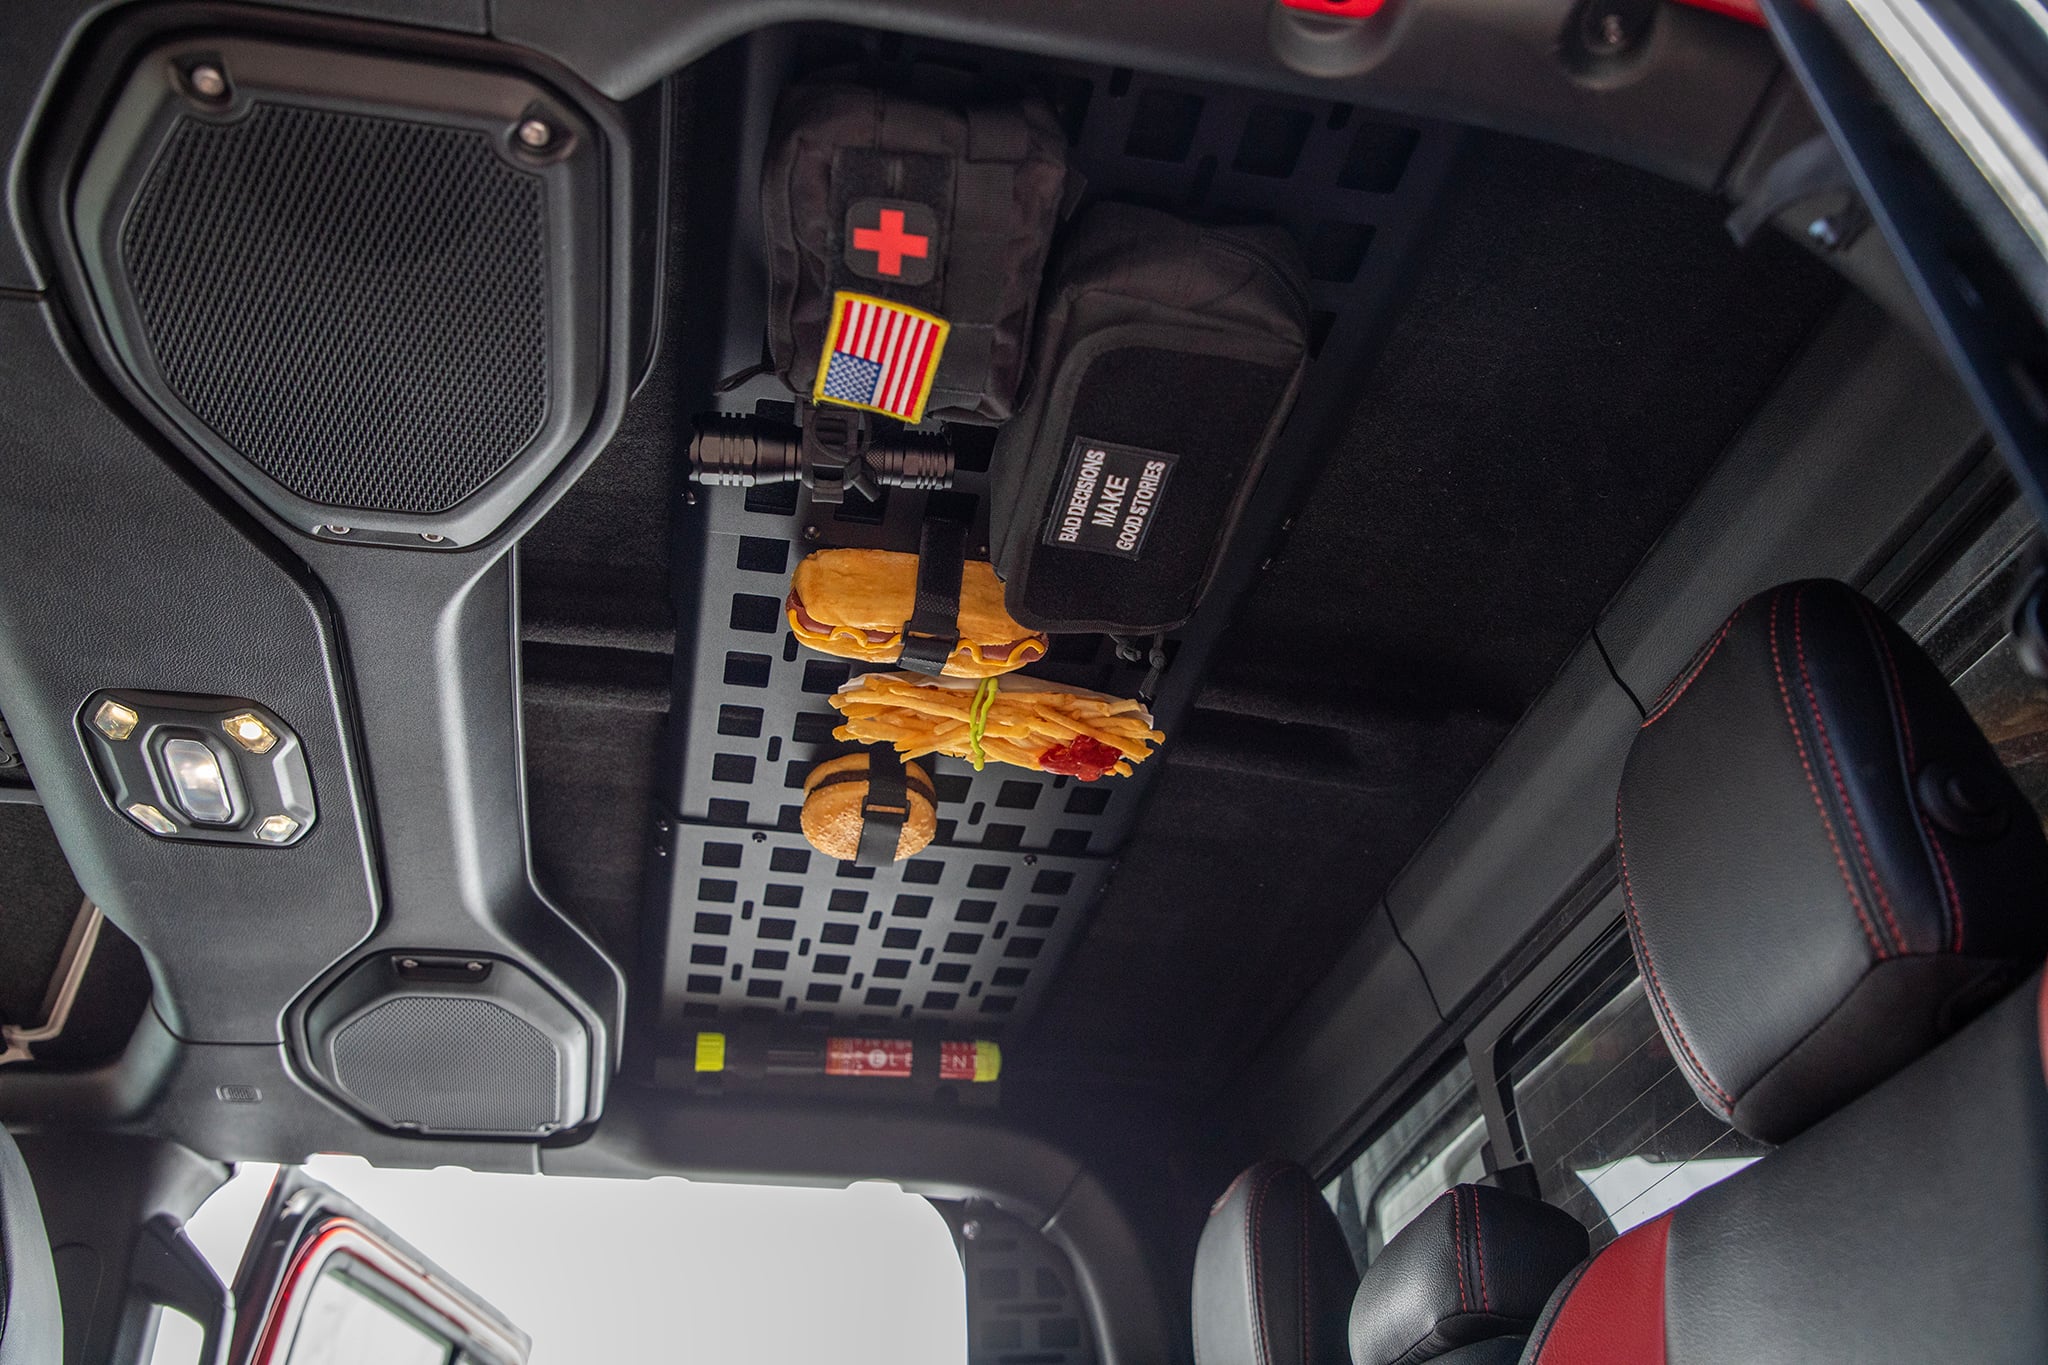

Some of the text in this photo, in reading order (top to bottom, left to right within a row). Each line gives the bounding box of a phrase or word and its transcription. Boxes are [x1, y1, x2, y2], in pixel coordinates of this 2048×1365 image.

[1058, 449, 1107, 543] BAD DECISIONS
[1091, 474, 1130, 528] MAKE
[1115, 460, 1166, 551] GOOD STORIES
